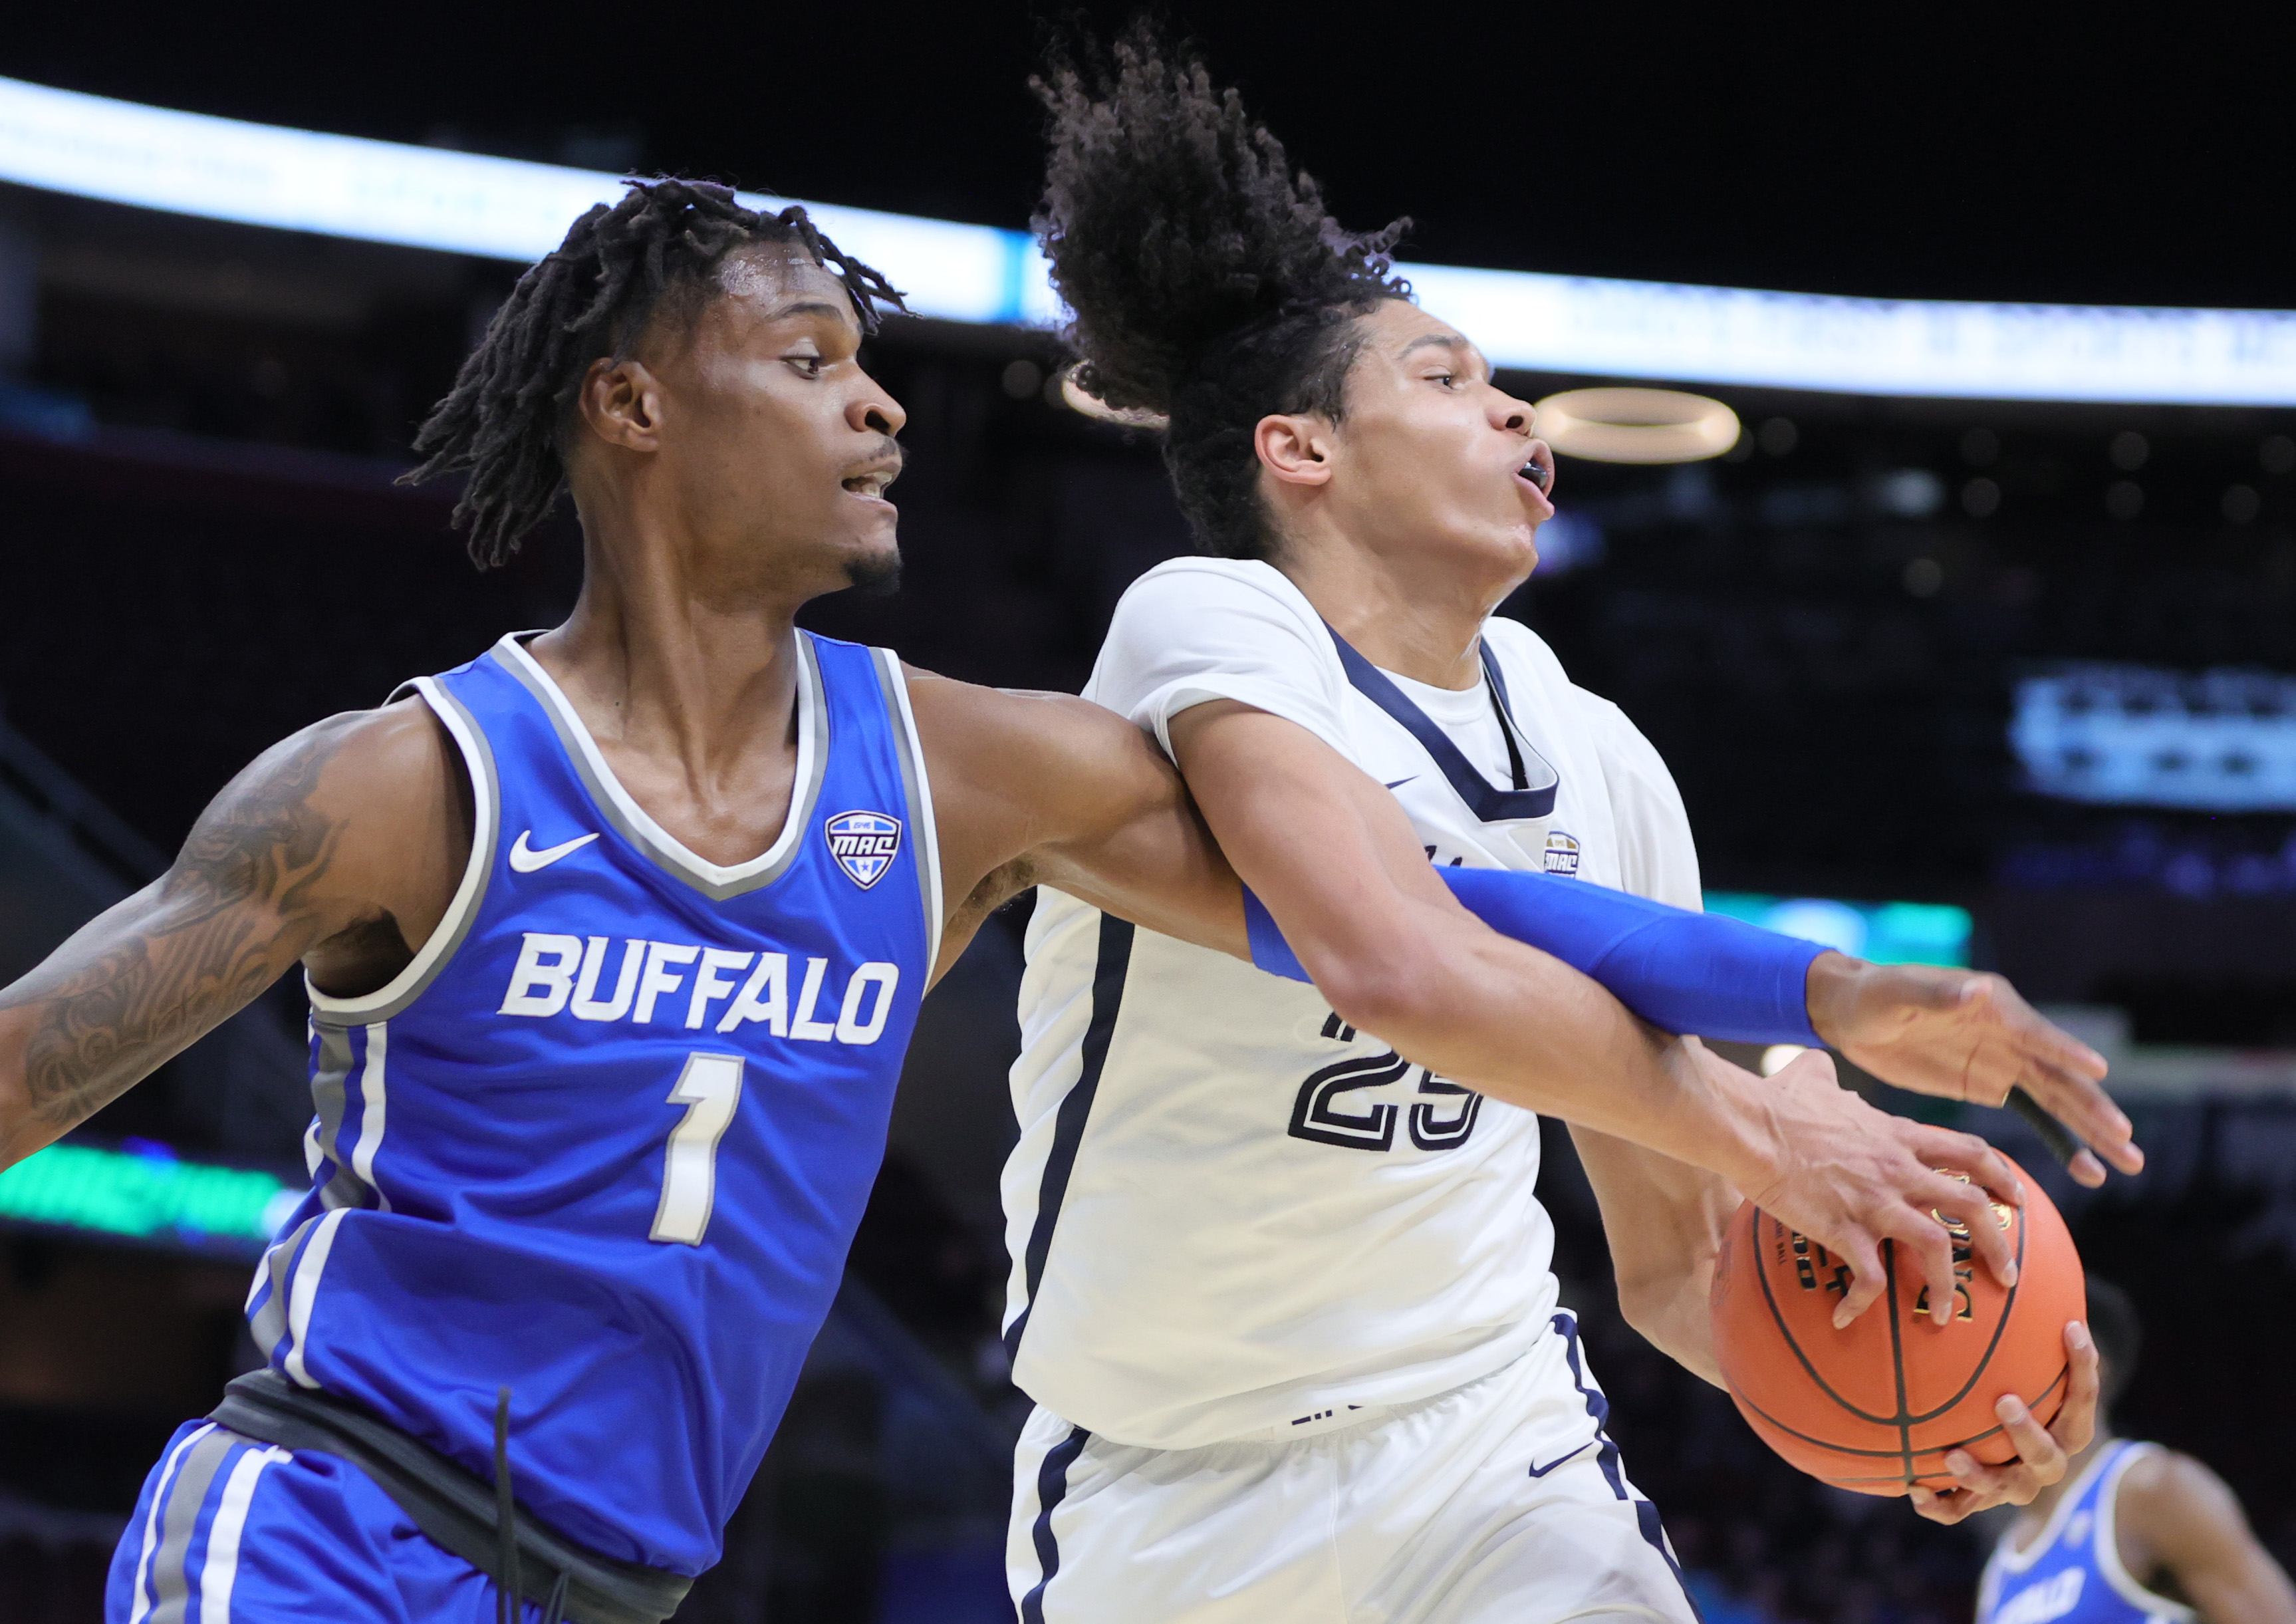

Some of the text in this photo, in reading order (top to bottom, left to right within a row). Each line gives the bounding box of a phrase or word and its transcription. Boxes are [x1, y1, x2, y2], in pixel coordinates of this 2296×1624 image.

[832, 836, 896, 855] MAC
[1545, 853, 1578, 872] MAC
[497, 932, 899, 1045] BUFFALO
[648, 1051, 745, 1246] 1
